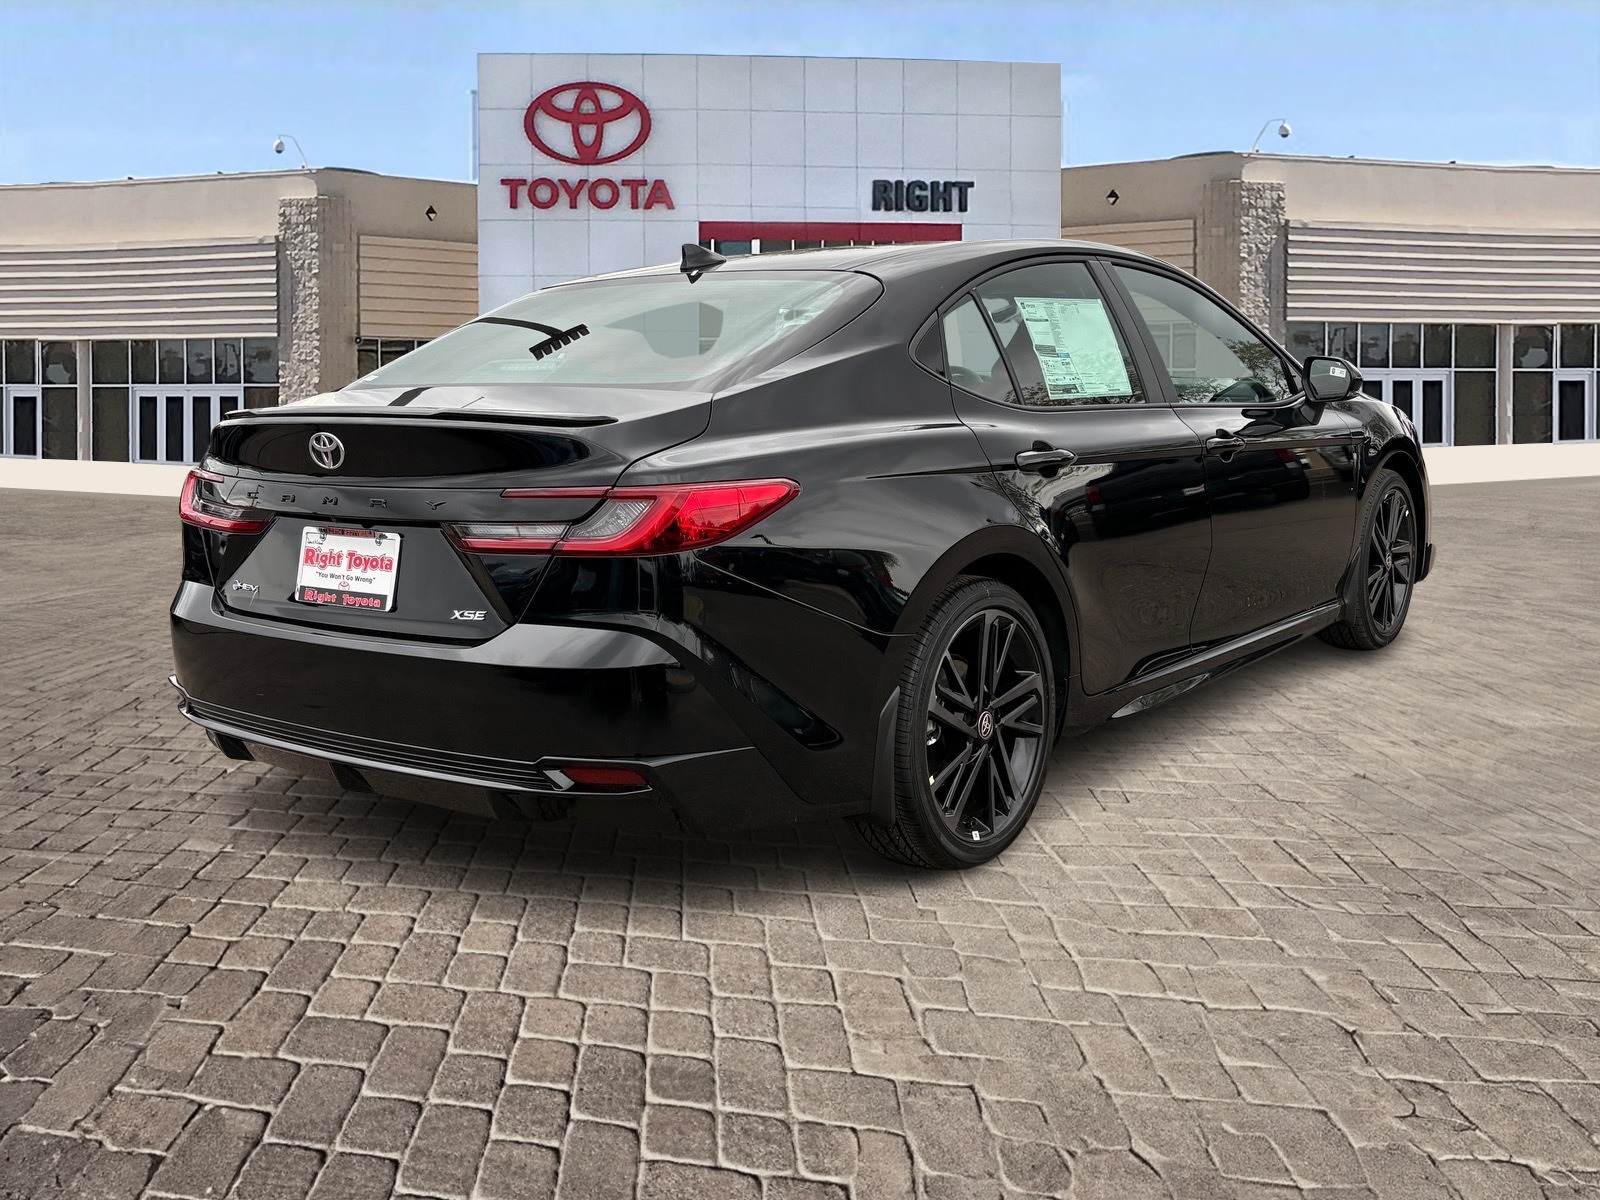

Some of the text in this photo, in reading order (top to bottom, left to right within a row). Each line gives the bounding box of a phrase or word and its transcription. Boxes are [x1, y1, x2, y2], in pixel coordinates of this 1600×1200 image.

[500, 177, 676, 210] TOYOTA
[872, 179, 975, 213] RIGHT
[246, 489, 448, 511] CAMRY
[304, 547, 394, 573] Right Toyota
[316, 571, 328, 579] "You
[354, 576, 376, 584] Wrong"
[304, 589, 381, 607] Right Toyota
[450, 609, 488, 621] XSE
